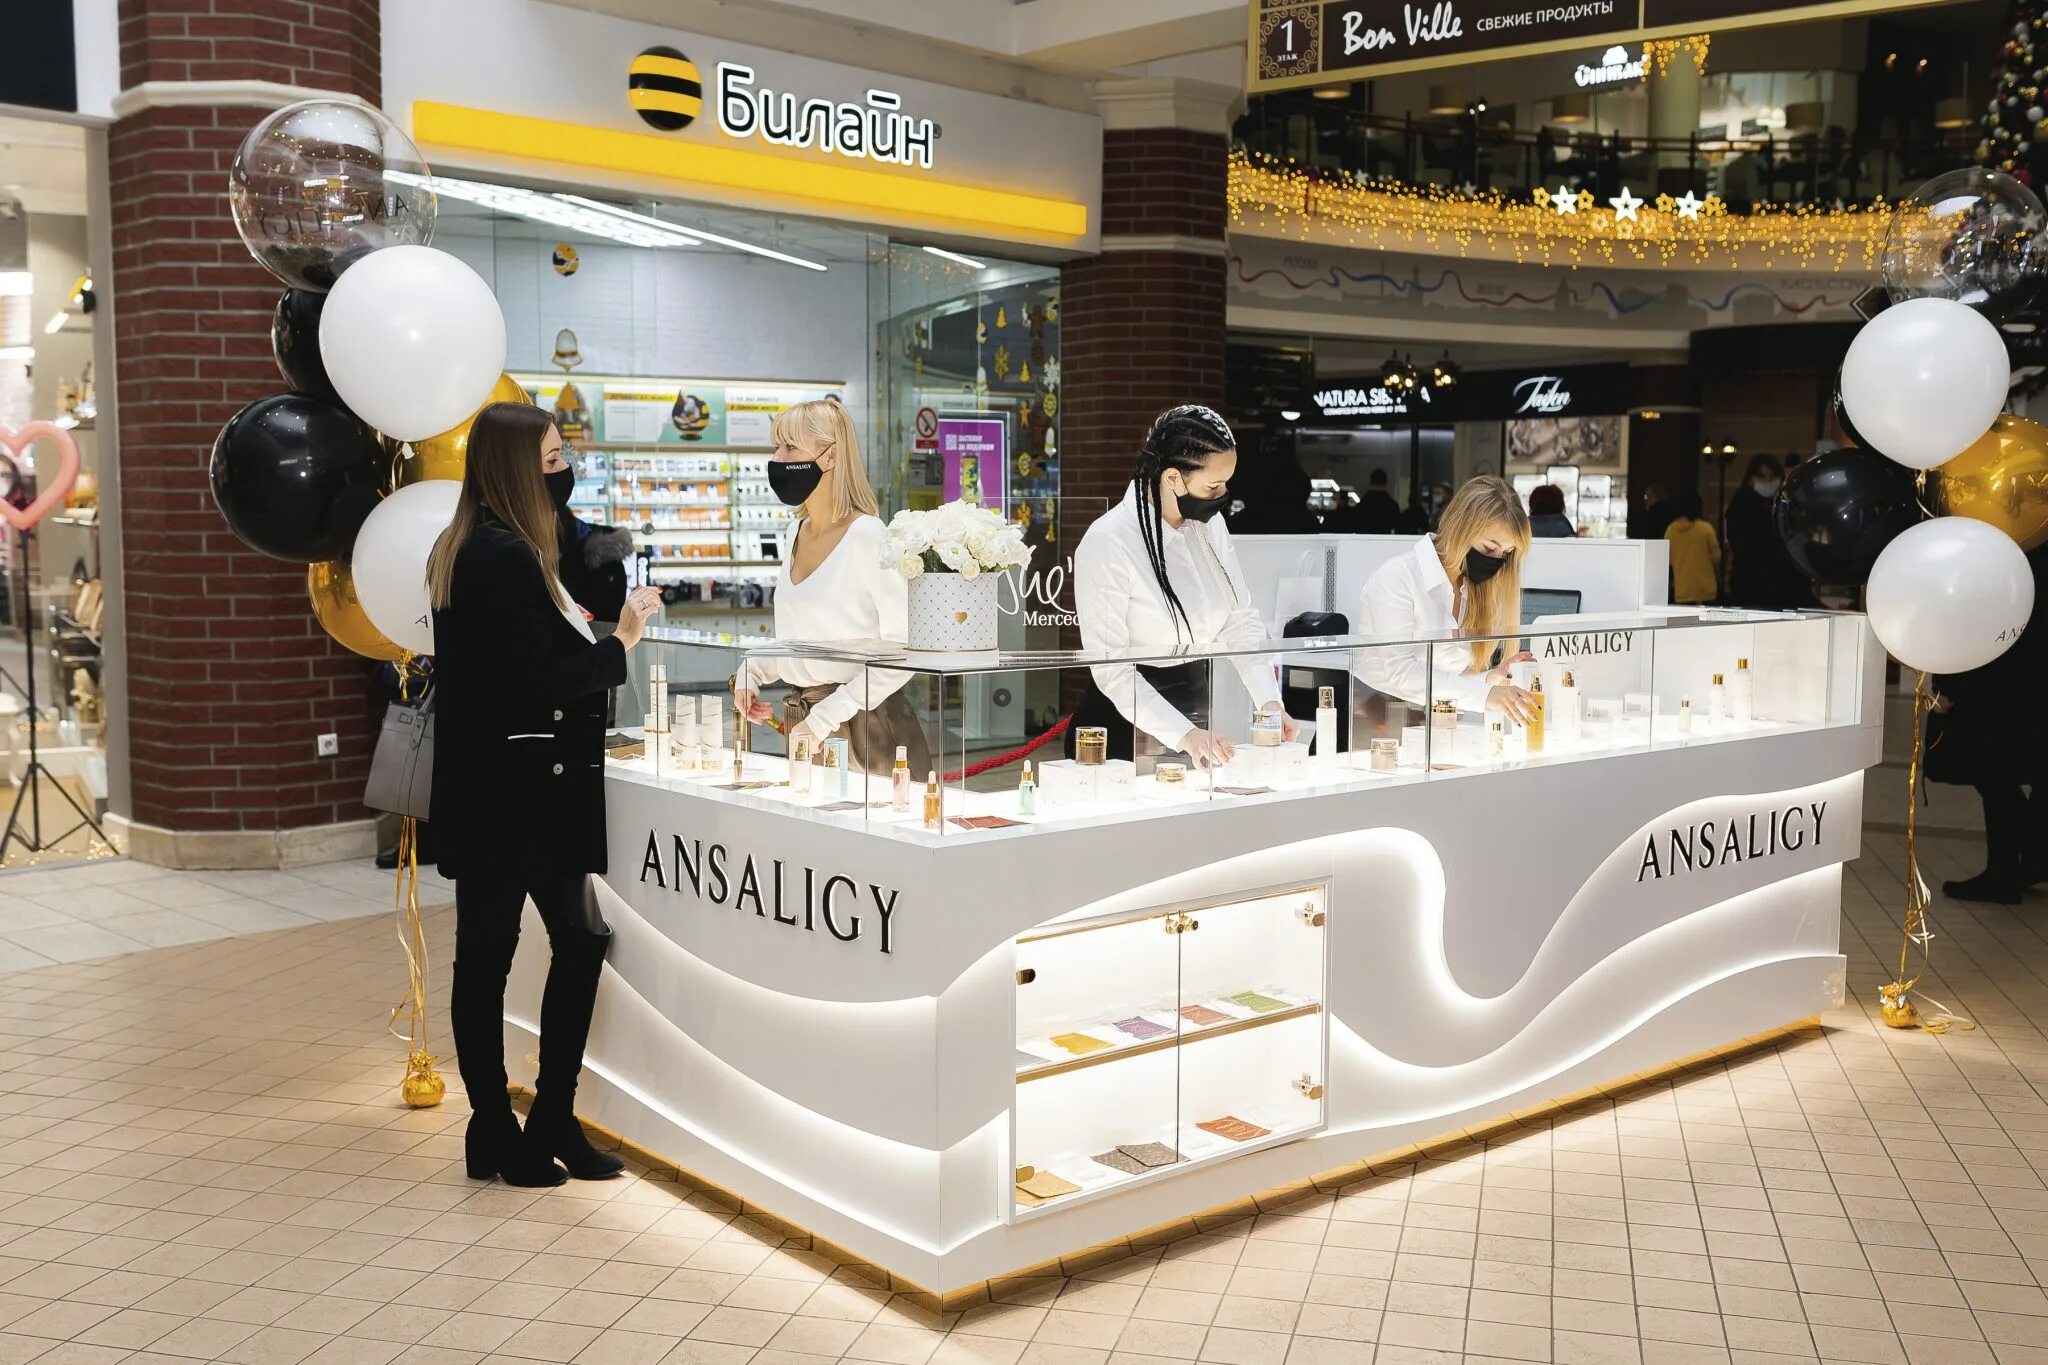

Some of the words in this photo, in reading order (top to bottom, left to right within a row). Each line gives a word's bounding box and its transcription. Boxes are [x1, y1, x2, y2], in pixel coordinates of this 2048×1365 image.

[1281, 19, 1293, 51] 1
[1342, 11, 1396, 55] Bon
[1404, 1, 1463, 46] Ville
[1476, 12, 1533, 32] СВЕЖИЕ
[1536, 1, 1613, 24] ПРОДУКТЫ
[1277, 54, 1298, 62] ЭТАЖ
[717, 61, 934, 169] Билайн
[1544, 631, 1633, 658] ANSALIGY
[1635, 801, 1827, 882] ANSALIGY
[639, 828, 900, 955] ANSALIGY
